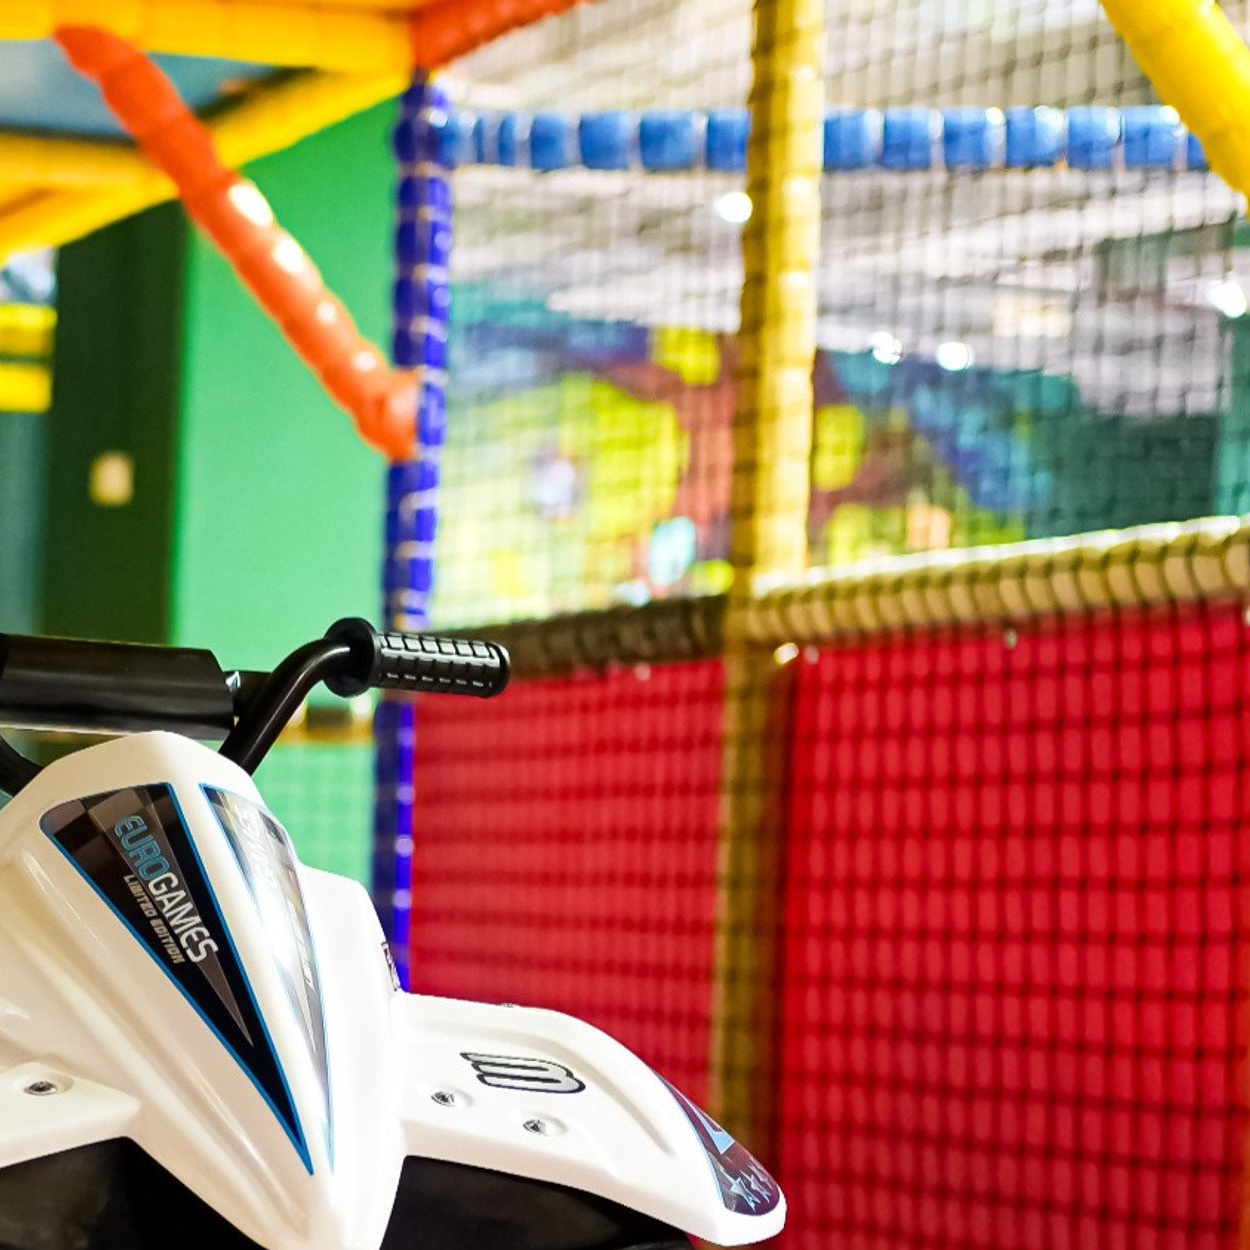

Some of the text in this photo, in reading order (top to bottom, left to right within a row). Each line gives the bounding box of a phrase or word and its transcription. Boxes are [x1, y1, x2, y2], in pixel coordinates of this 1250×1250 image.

[114, 814, 219, 963] EUROGAMES
[123, 875, 186, 964] LIMITED EDITION
